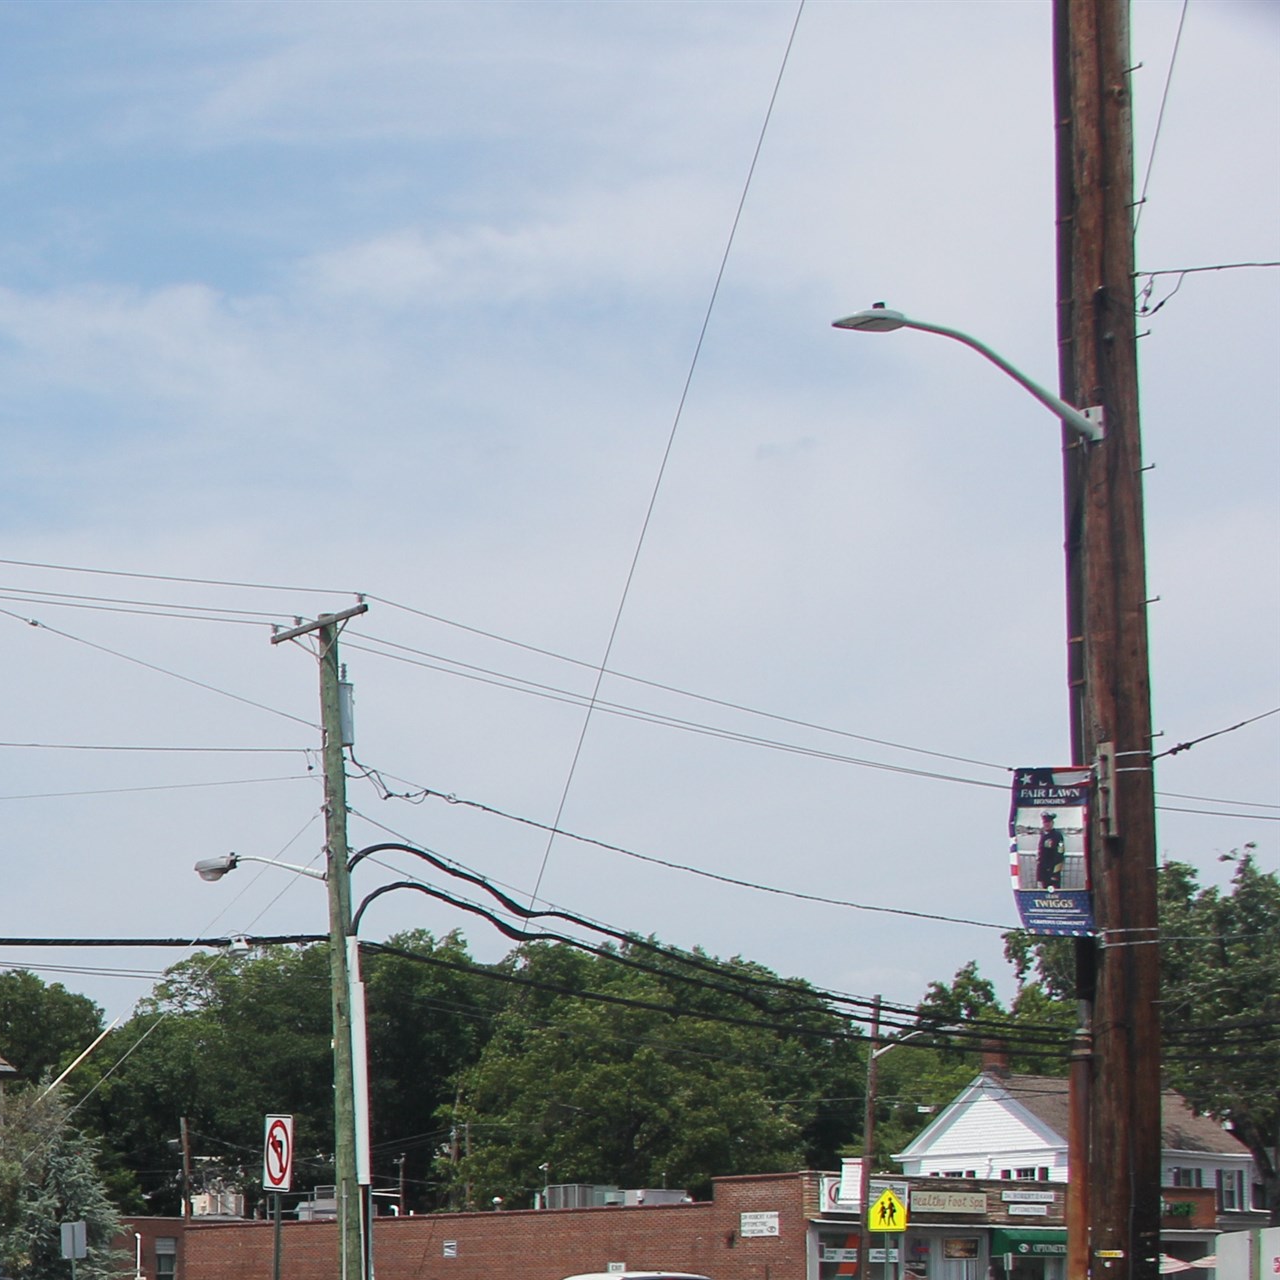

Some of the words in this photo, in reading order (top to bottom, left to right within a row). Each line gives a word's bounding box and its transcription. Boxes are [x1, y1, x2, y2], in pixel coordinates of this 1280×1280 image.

[1020, 788, 1046, 798] FAIR
[1048, 788, 1080, 798] LAWN
[1033, 899, 1073, 908] TWIGGS
[912, 1194, 945, 1210] Healthy
[948, 1195, 967, 1207] Foot
[969, 1196, 984, 1210] Spa
